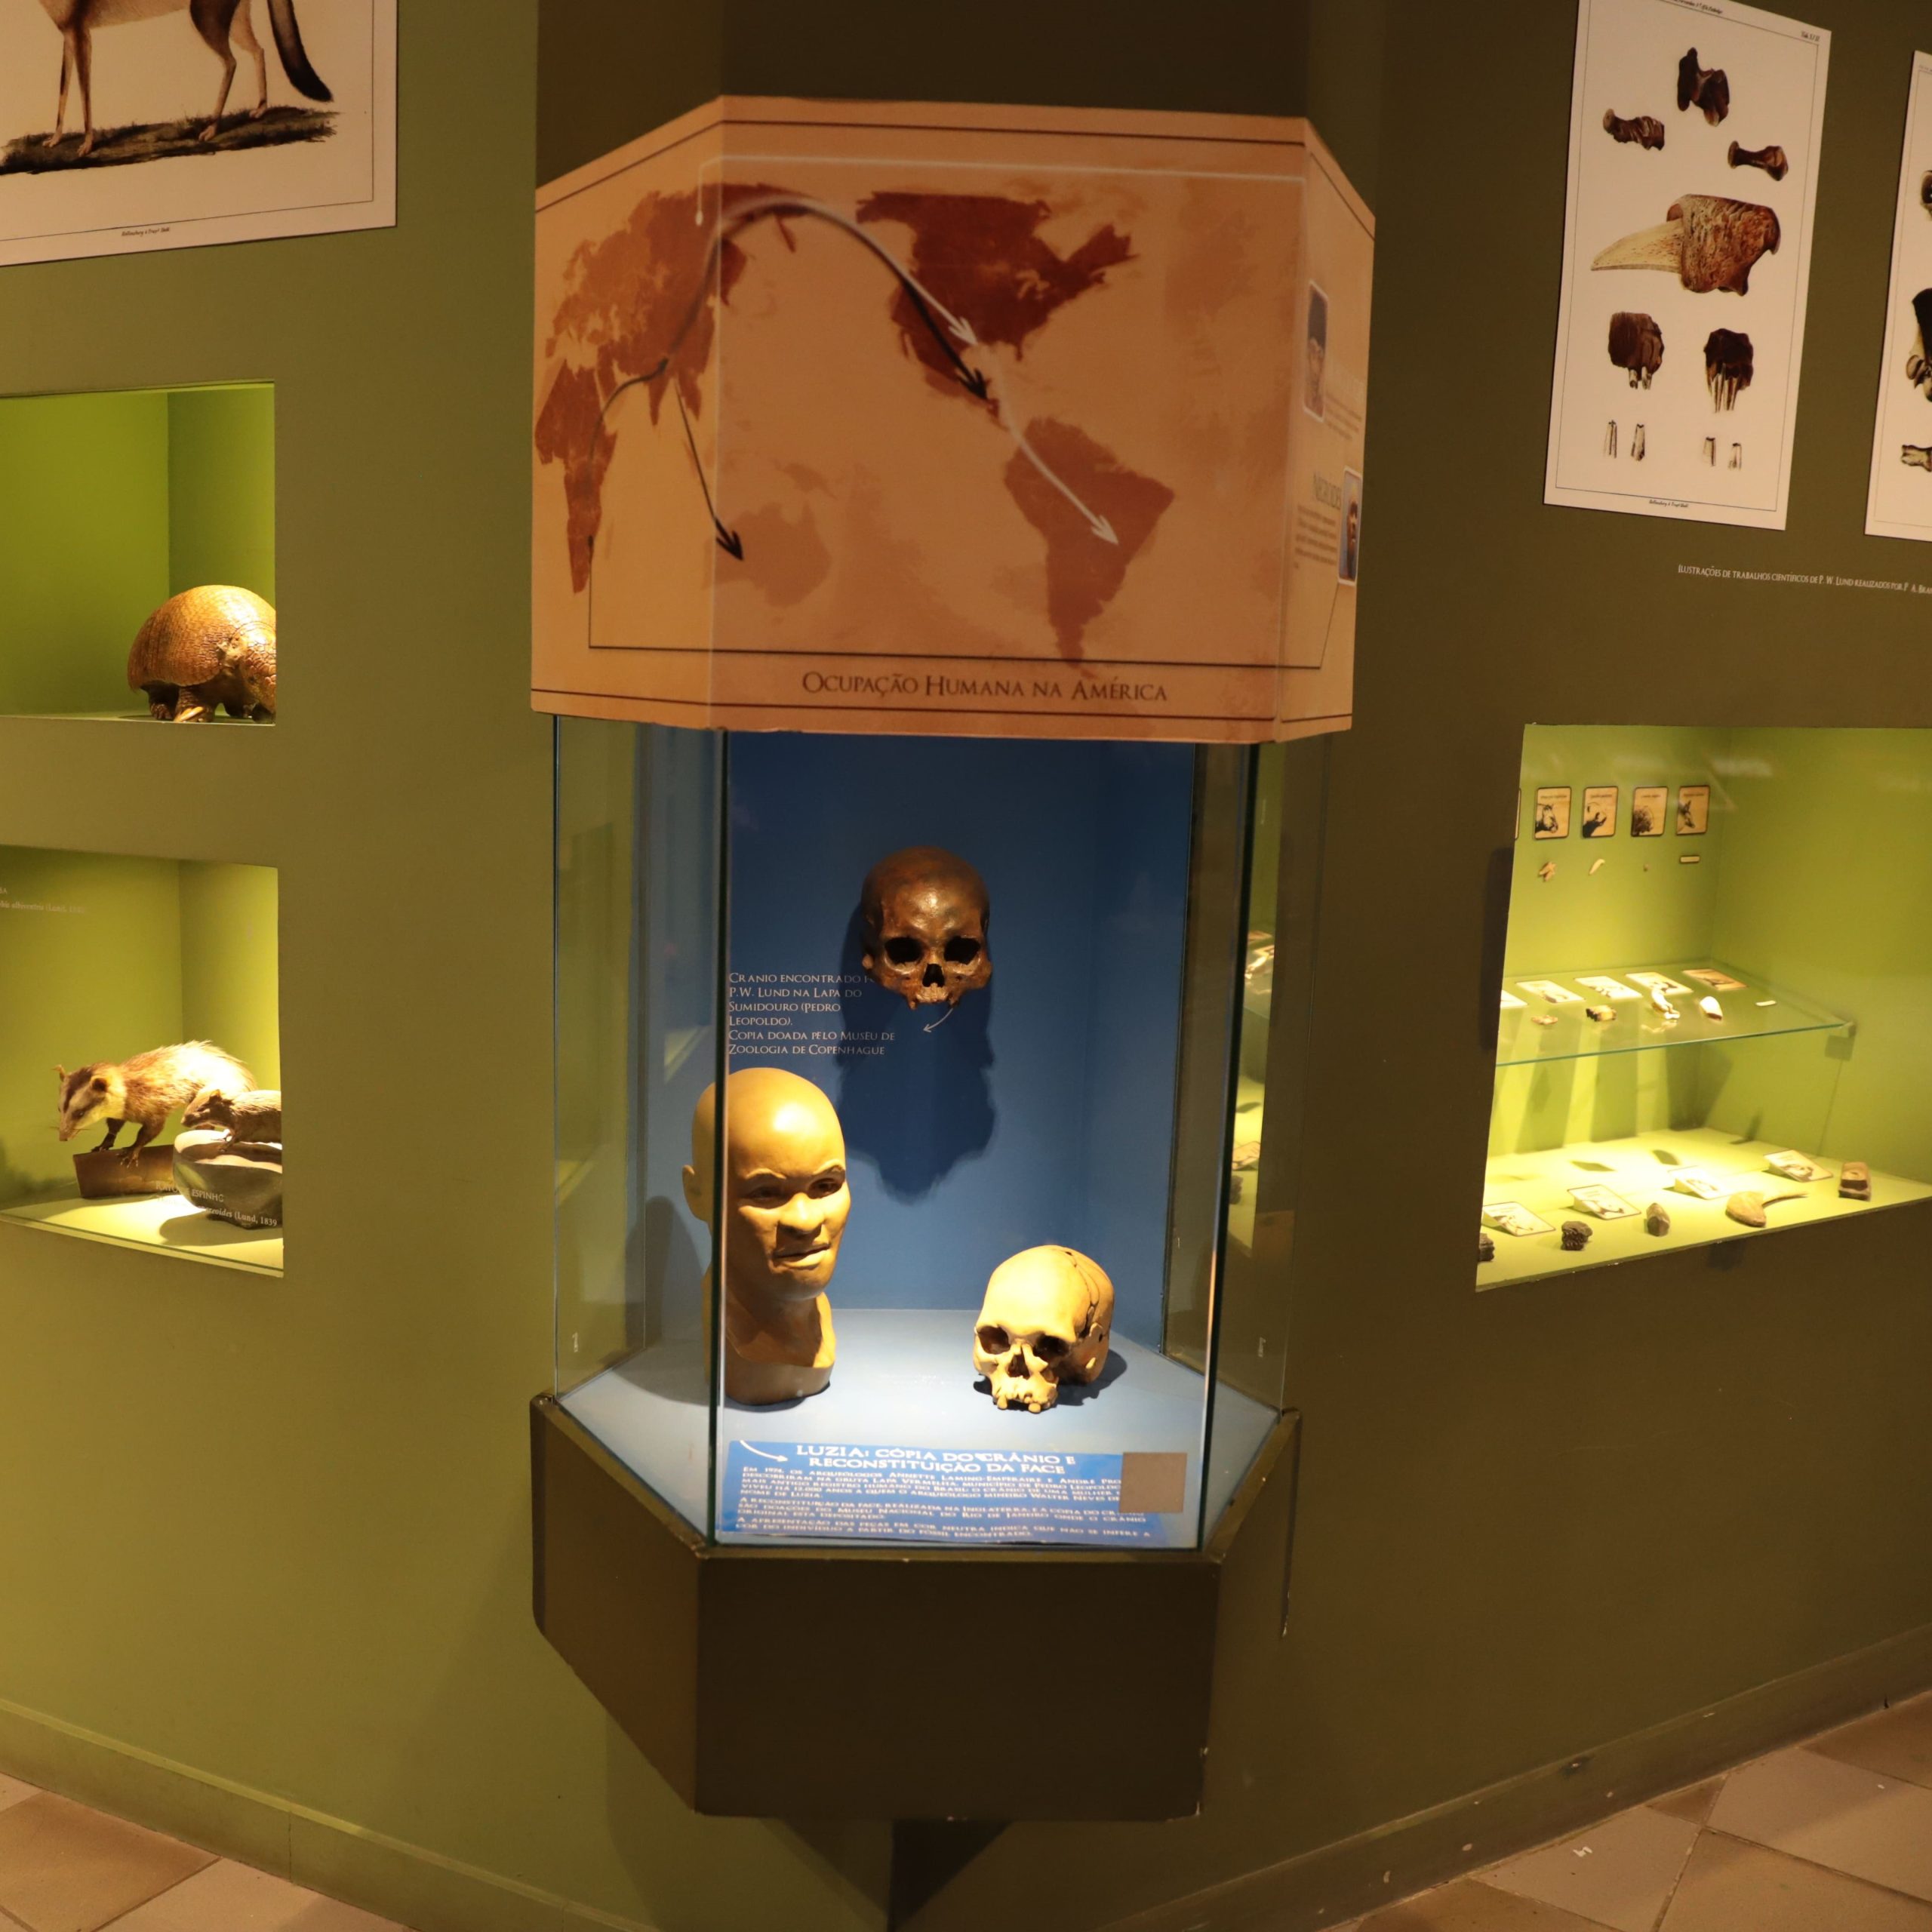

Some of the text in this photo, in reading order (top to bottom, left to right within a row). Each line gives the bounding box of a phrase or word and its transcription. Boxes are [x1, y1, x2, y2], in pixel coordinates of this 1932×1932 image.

[1678, 564, 1721, 577] ILUSTRAÇÕES
[1733, 571, 1770, 580] TRABALHOS
[1835, 577, 1854, 586] LUND
[802, 671, 1168, 701] OCUPAÇÃO HUMANA NA AMÉRICA
[780, 974, 861, 983] ENCONTRADO
[758, 988, 790, 998] LUND
[793, 989, 810, 998] NA
[814, 988, 841, 998] LAPA
[844, 989, 862, 998] DO
[728, 1001, 841, 1014] SUMIDOURO (PEDRO
[768, 1032, 808, 1041] DOADA
[811, 1031, 838, 1041] PELO
[840, 1031, 878, 1041] MUSEU
[881, 1032, 896, 1041] DE
[728, 1044, 885, 1055] ZOOLOGIA DE COPENHAGUE
[235, 1211, 258, 1224] (Lund,
[796, 1444, 1075, 1465] LUZIA: CÓPIA DO CRÂNIO E
[809, 1457, 1066, 1474] RECONSTITUIÇÃO DA FACE
[889, 1472, 935, 1480] ANNETTE
